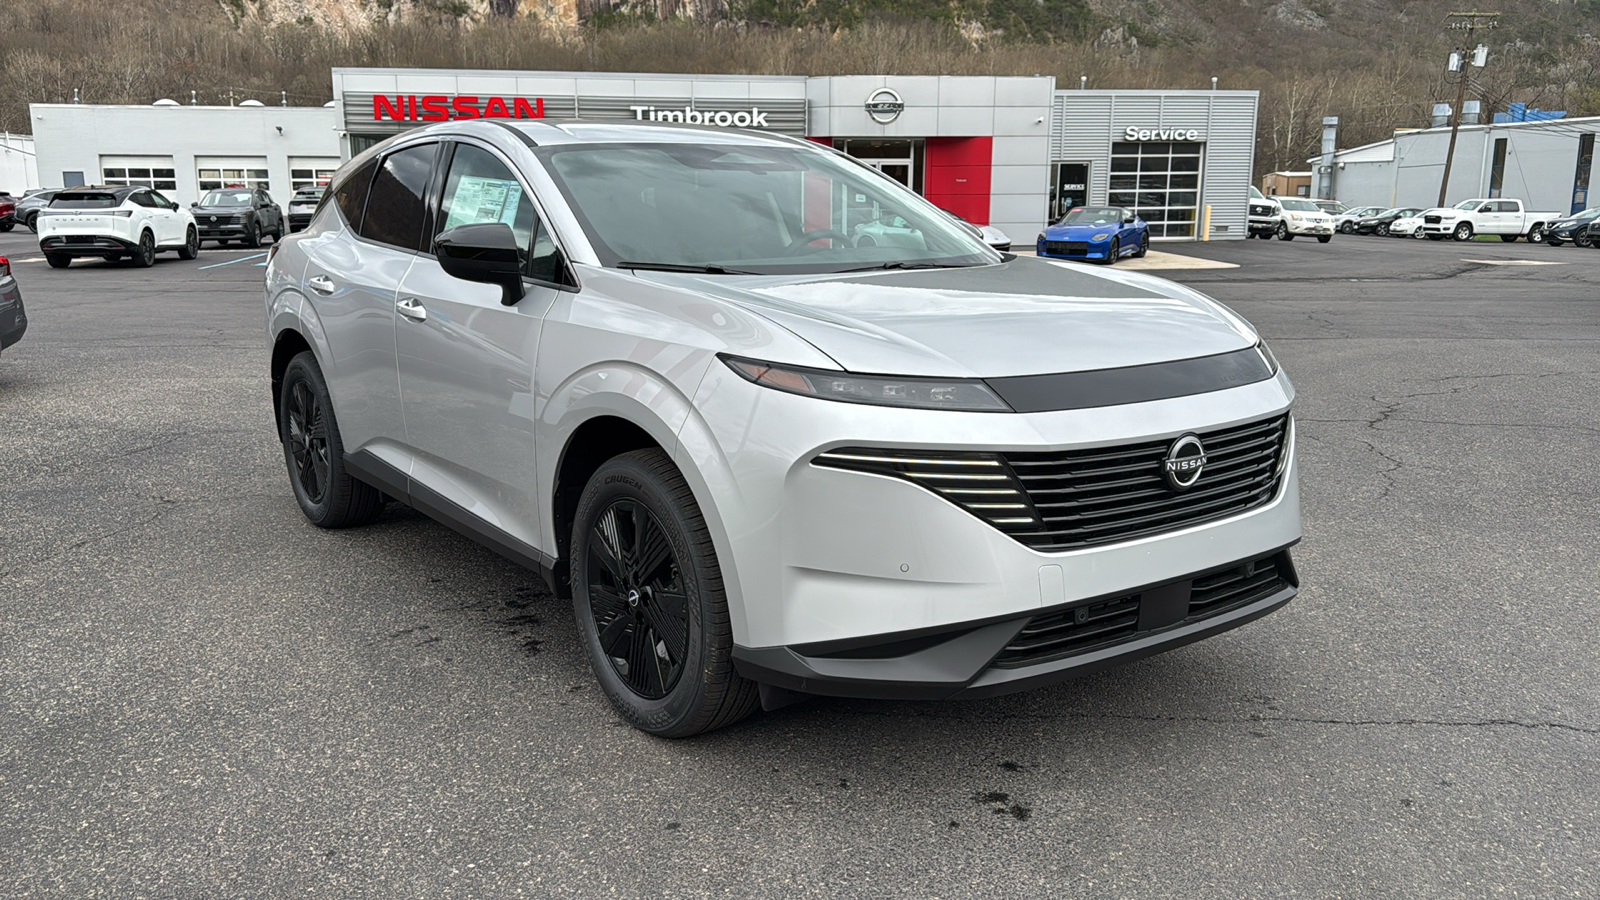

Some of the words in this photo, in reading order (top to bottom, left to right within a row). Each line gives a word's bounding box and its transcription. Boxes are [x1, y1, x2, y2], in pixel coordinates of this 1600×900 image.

[373, 94, 544, 121] NISSAN
[630, 106, 769, 127] Timbrook
[1125, 126, 1198, 141] Service
[1166, 456, 1207, 471] NISSAN
[604, 475, 642, 491] CRUGEN
